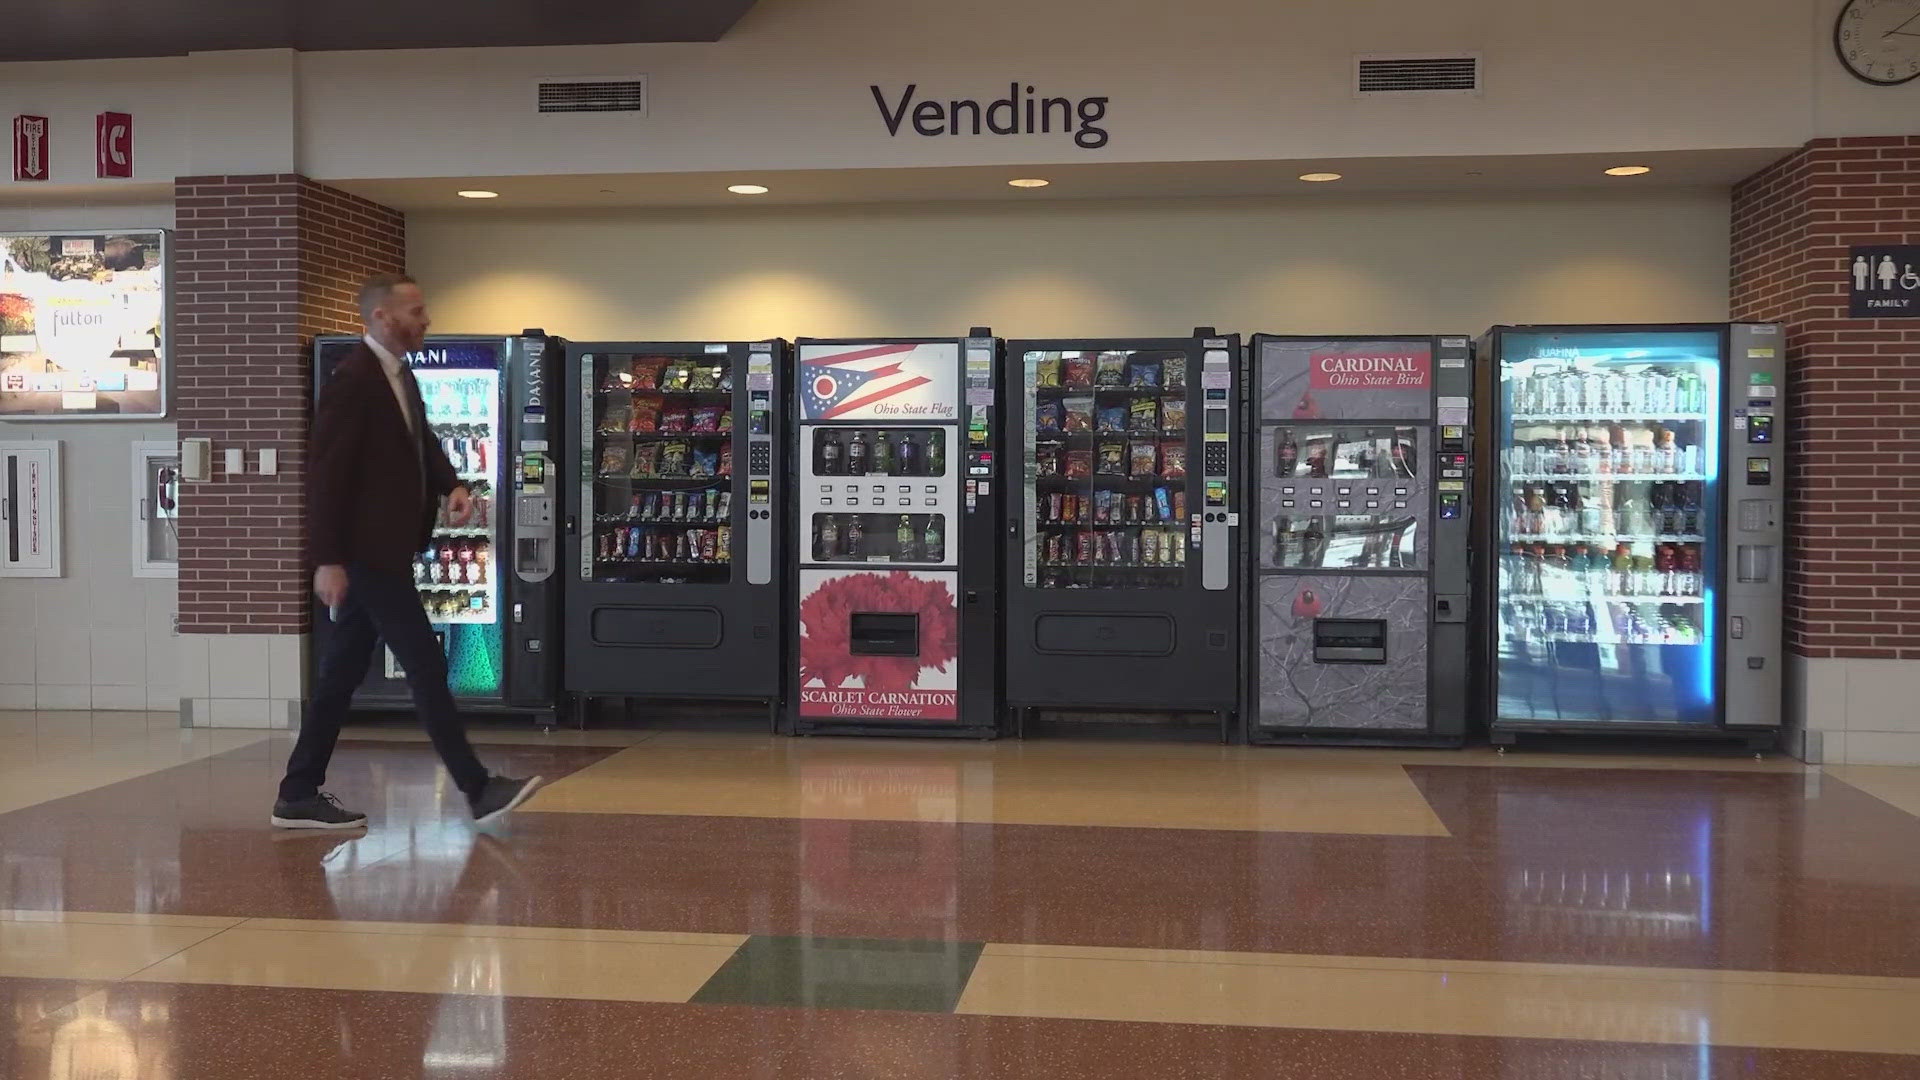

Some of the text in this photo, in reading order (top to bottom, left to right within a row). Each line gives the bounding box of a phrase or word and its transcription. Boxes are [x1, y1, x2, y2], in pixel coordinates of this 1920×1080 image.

[870, 82, 1108, 149] Vending
[25, 123, 41, 134] FIRE
[1867, 299, 1909, 308] FAMILY
[54, 310, 103, 337] fulton
[1320, 357, 1418, 372] CARDINAL
[527, 353, 544, 406] DASANI
[1329, 372, 1425, 386] Ohio State Bird
[874, 402, 954, 417] Ohio State Flag
[801, 691, 956, 706] SCARLET CARNATION
[831, 703, 923, 718] Ohio State Flower
